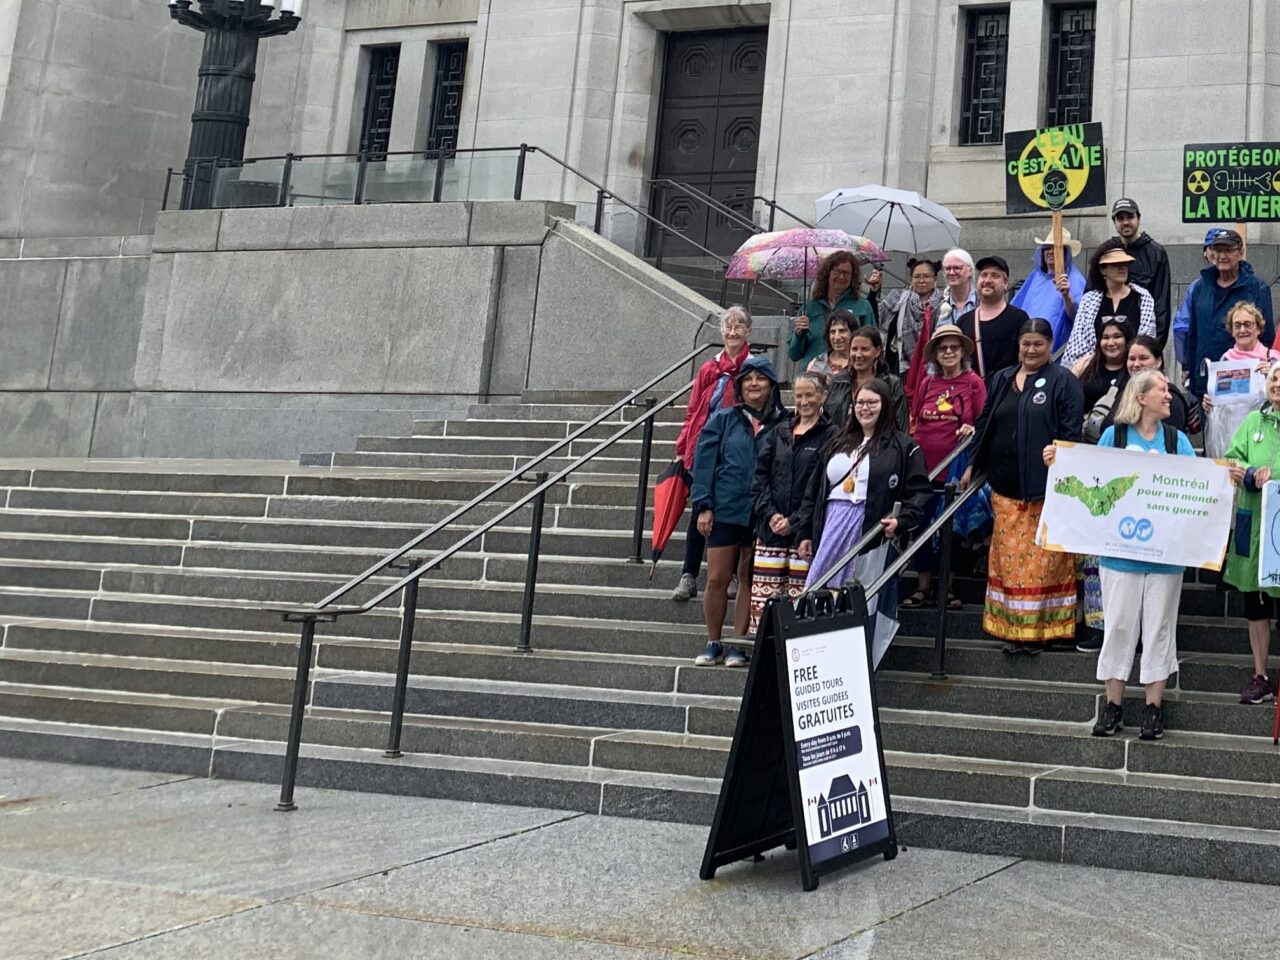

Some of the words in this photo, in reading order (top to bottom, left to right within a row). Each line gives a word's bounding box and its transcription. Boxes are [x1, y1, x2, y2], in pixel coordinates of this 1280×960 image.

[1070, 145, 1101, 167] VIE
[1185, 195, 1211, 219] LA
[1152, 473, 1210, 491] Montréal
[1136, 488, 1163, 499] pour
[1165, 490, 1179, 499] un
[1181, 491, 1219, 505] monde
[1146, 502, 1170, 513] sans
[1172, 505, 1209, 517] guerre
[793, 664, 819, 684] FREE
[794, 682, 821, 697] GUIDED
[821, 676, 844, 690] TOURS
[796, 697, 821, 711] VISITES
[798, 702, 855, 730] GRATUITES
